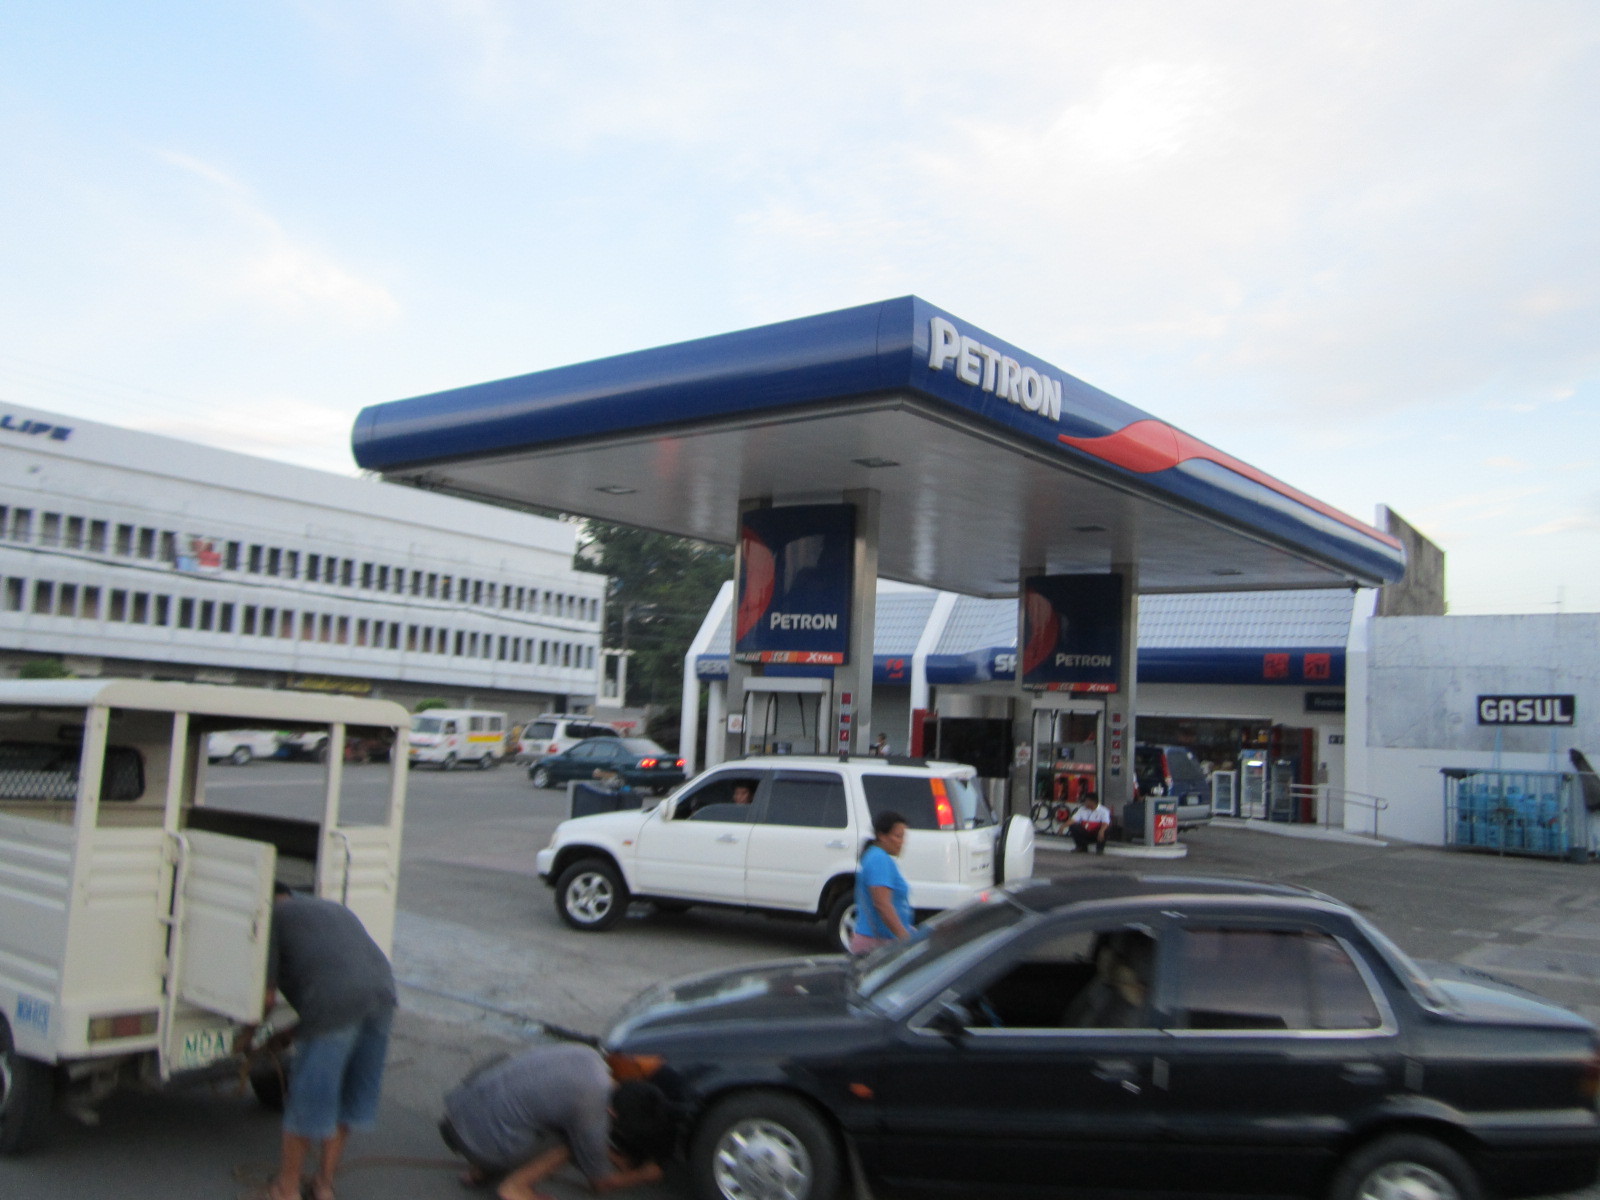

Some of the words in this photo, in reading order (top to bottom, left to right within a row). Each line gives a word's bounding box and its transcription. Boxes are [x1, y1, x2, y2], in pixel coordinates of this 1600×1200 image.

[928, 316, 1062, 422] PETRON
[0, 414, 73, 441] LIFE
[770, 612, 838, 630] PETRON
[1055, 653, 1112, 667] PETRON
[1480, 699, 1572, 722] GASUL
